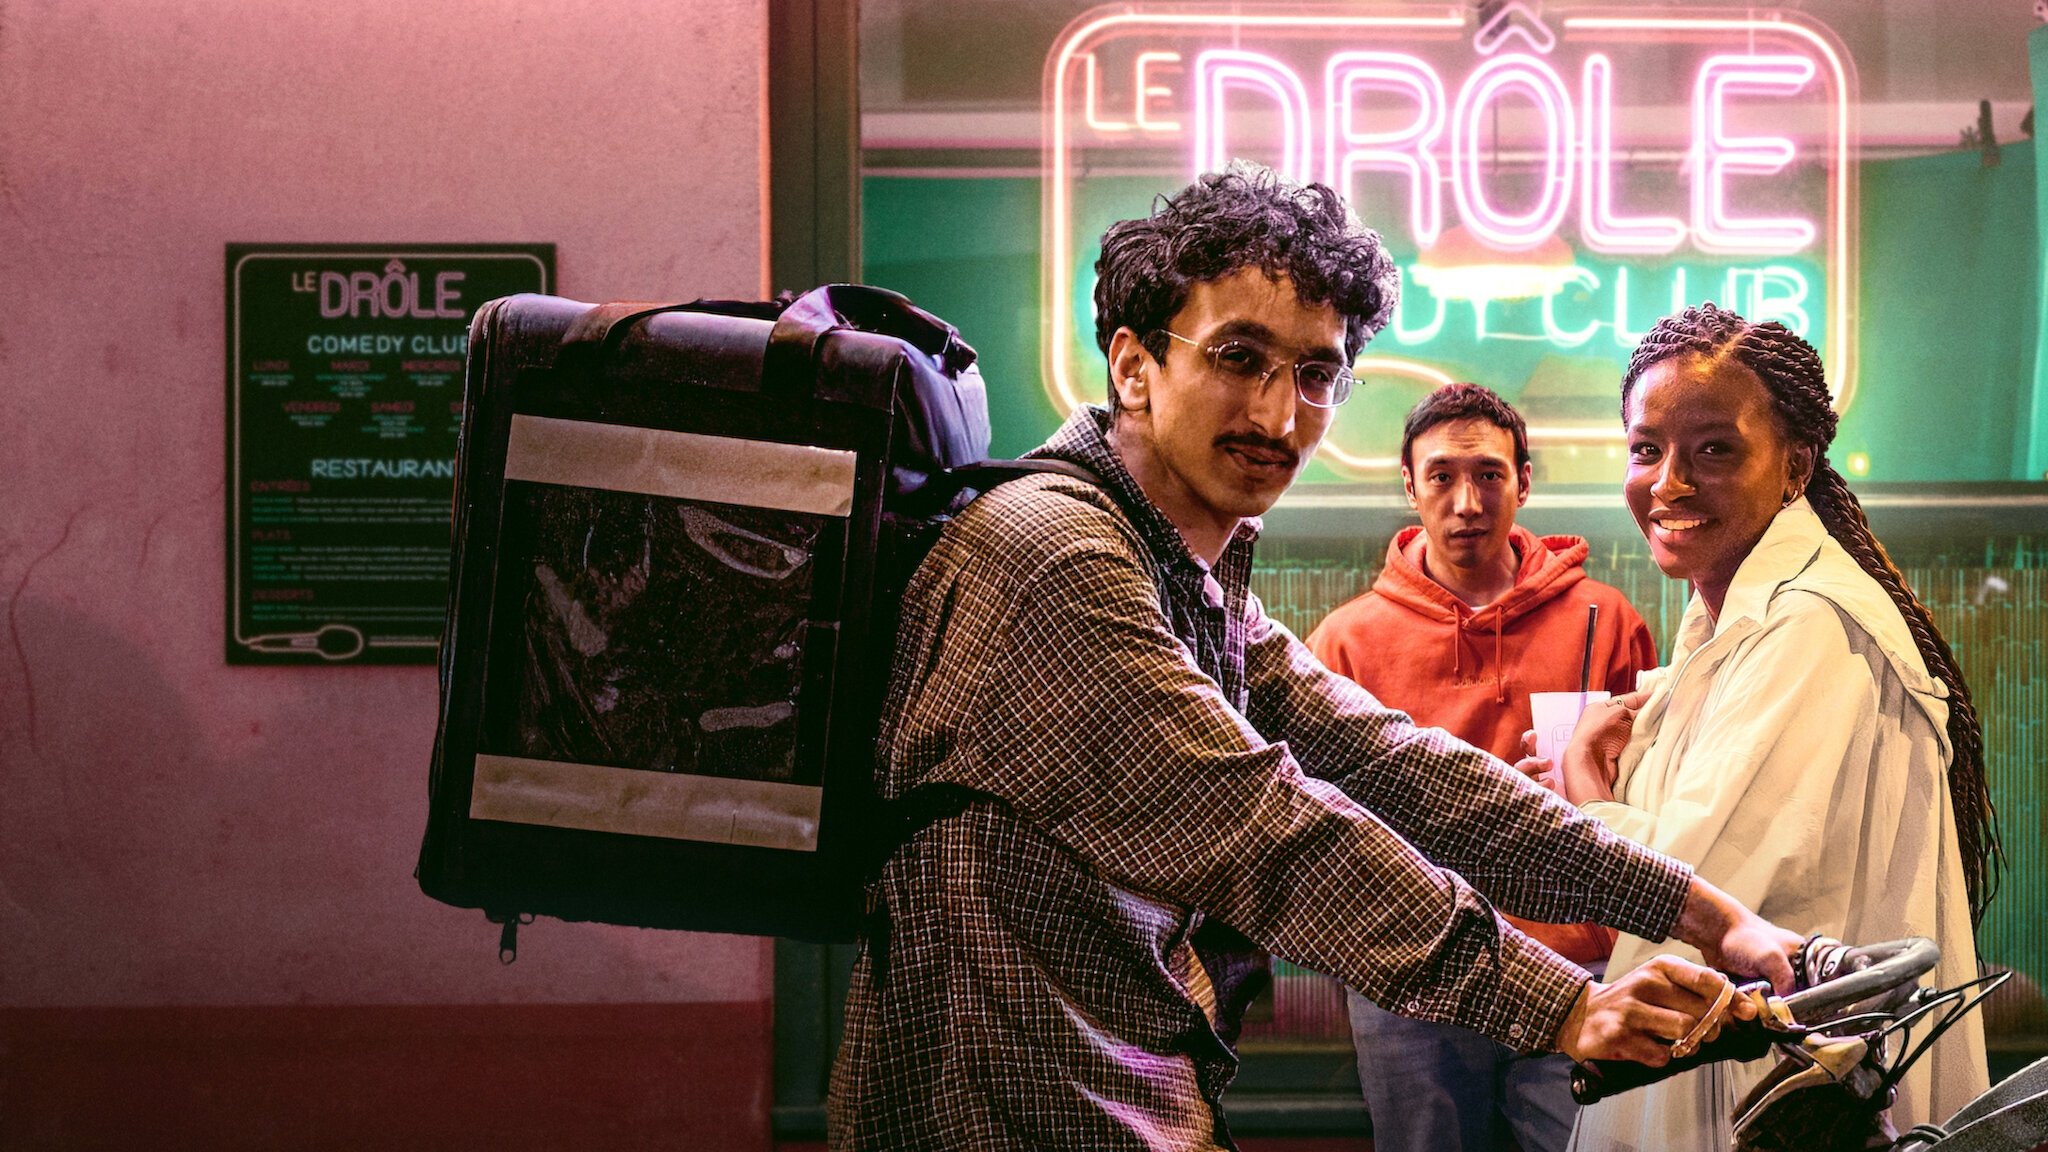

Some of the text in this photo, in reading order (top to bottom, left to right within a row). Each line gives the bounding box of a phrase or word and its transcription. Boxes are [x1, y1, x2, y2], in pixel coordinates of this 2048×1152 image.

[1085, 3, 1816, 252] LE DRÔLE
[292, 257, 466, 318] LE DRÔLE
[307, 334, 405, 354] COMEDY
[311, 459, 455, 478] RESTAURAN
